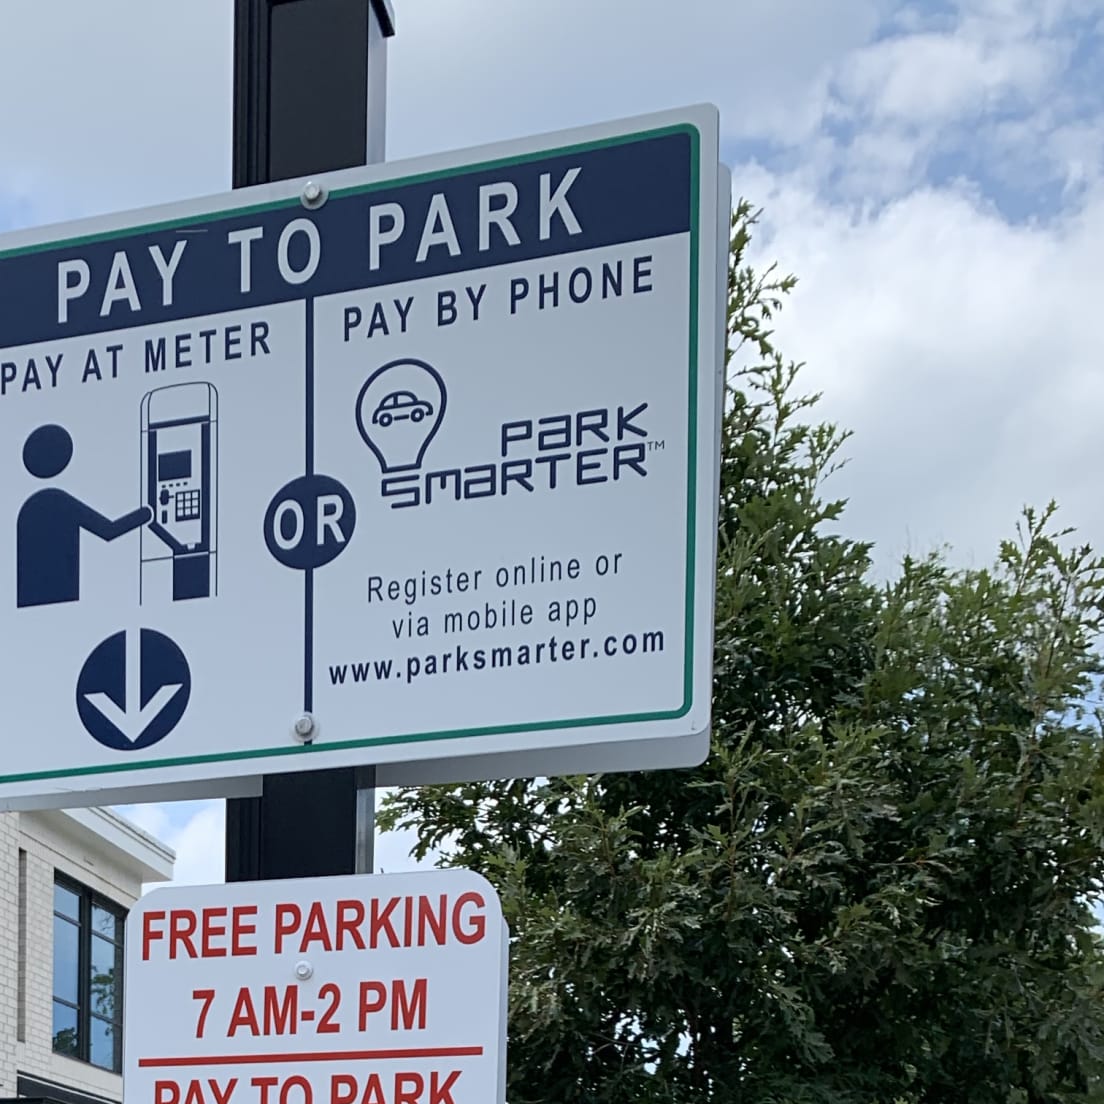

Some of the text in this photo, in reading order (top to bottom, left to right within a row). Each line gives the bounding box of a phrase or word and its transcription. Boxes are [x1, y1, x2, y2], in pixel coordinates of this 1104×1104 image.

[58, 168, 582, 323] PAY TO PARK
[344, 256, 652, 342] PAY BY PHONE
[1, 322, 270, 395] PAY AT METER
[274, 495, 345, 549] OR
[368, 554, 622, 605] Register online or
[393, 598, 596, 638] via mobile app
[329, 631, 663, 684] www.parksmarter.com
[143, 892, 485, 960] FREE PARKING
[193, 989, 215, 1037] 7
[359, 979, 427, 1031] PM
